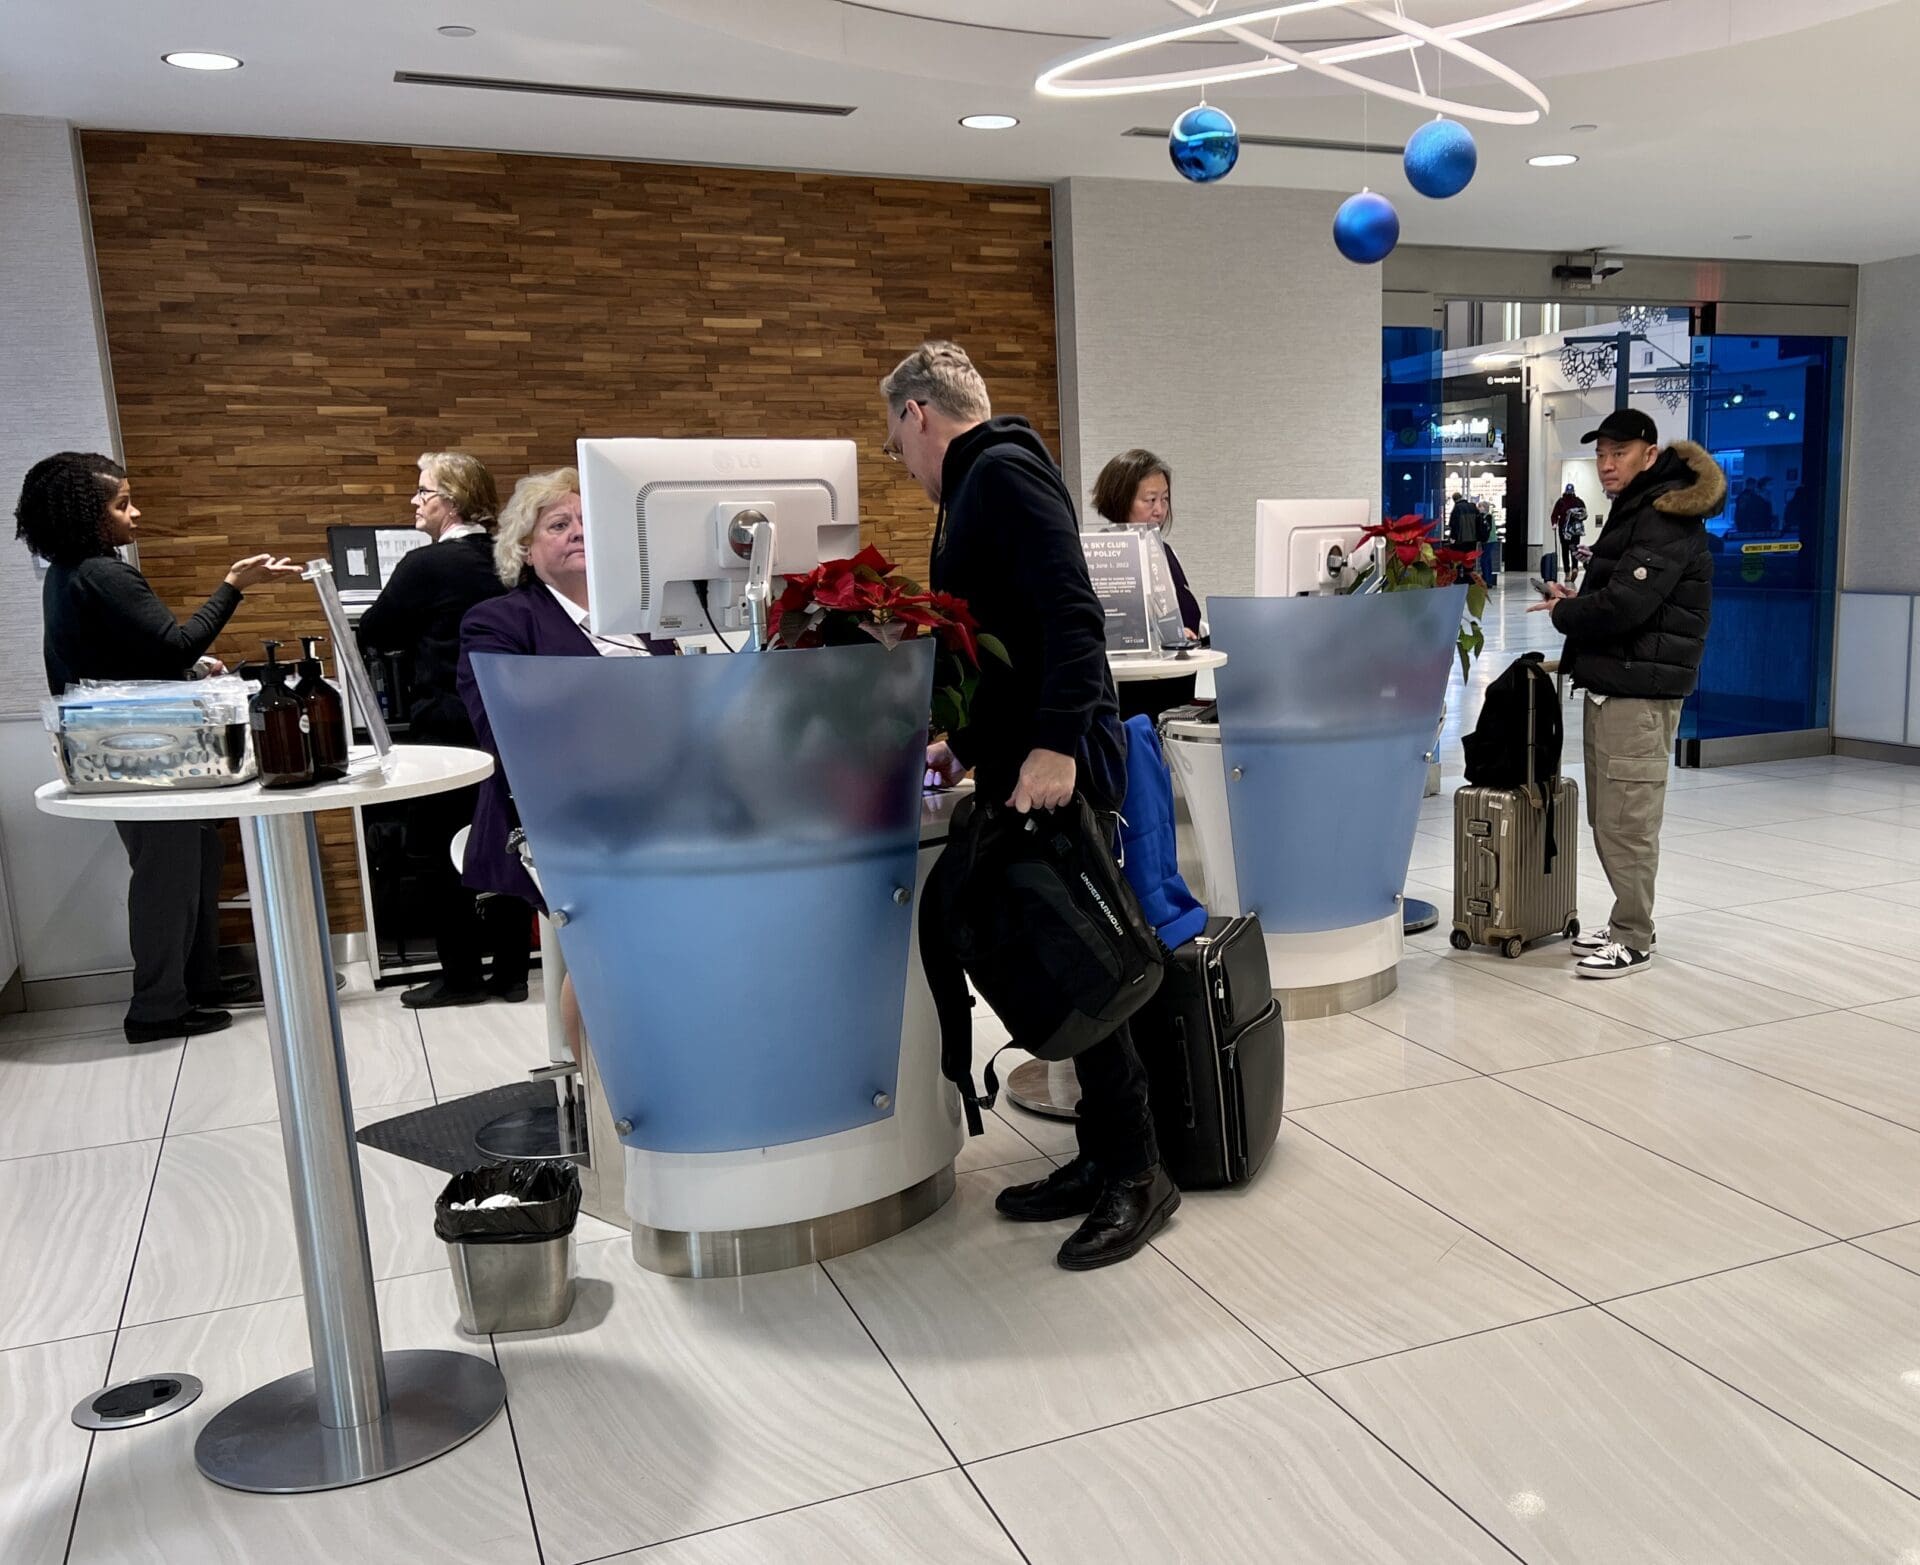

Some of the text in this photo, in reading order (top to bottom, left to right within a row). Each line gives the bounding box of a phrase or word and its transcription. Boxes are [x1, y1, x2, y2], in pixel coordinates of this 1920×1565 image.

[1090, 542, 1105, 550] SKY
[1093, 550, 1121, 558] POLICY
[1080, 872, 1124, 936] UNDER ARMOUR
